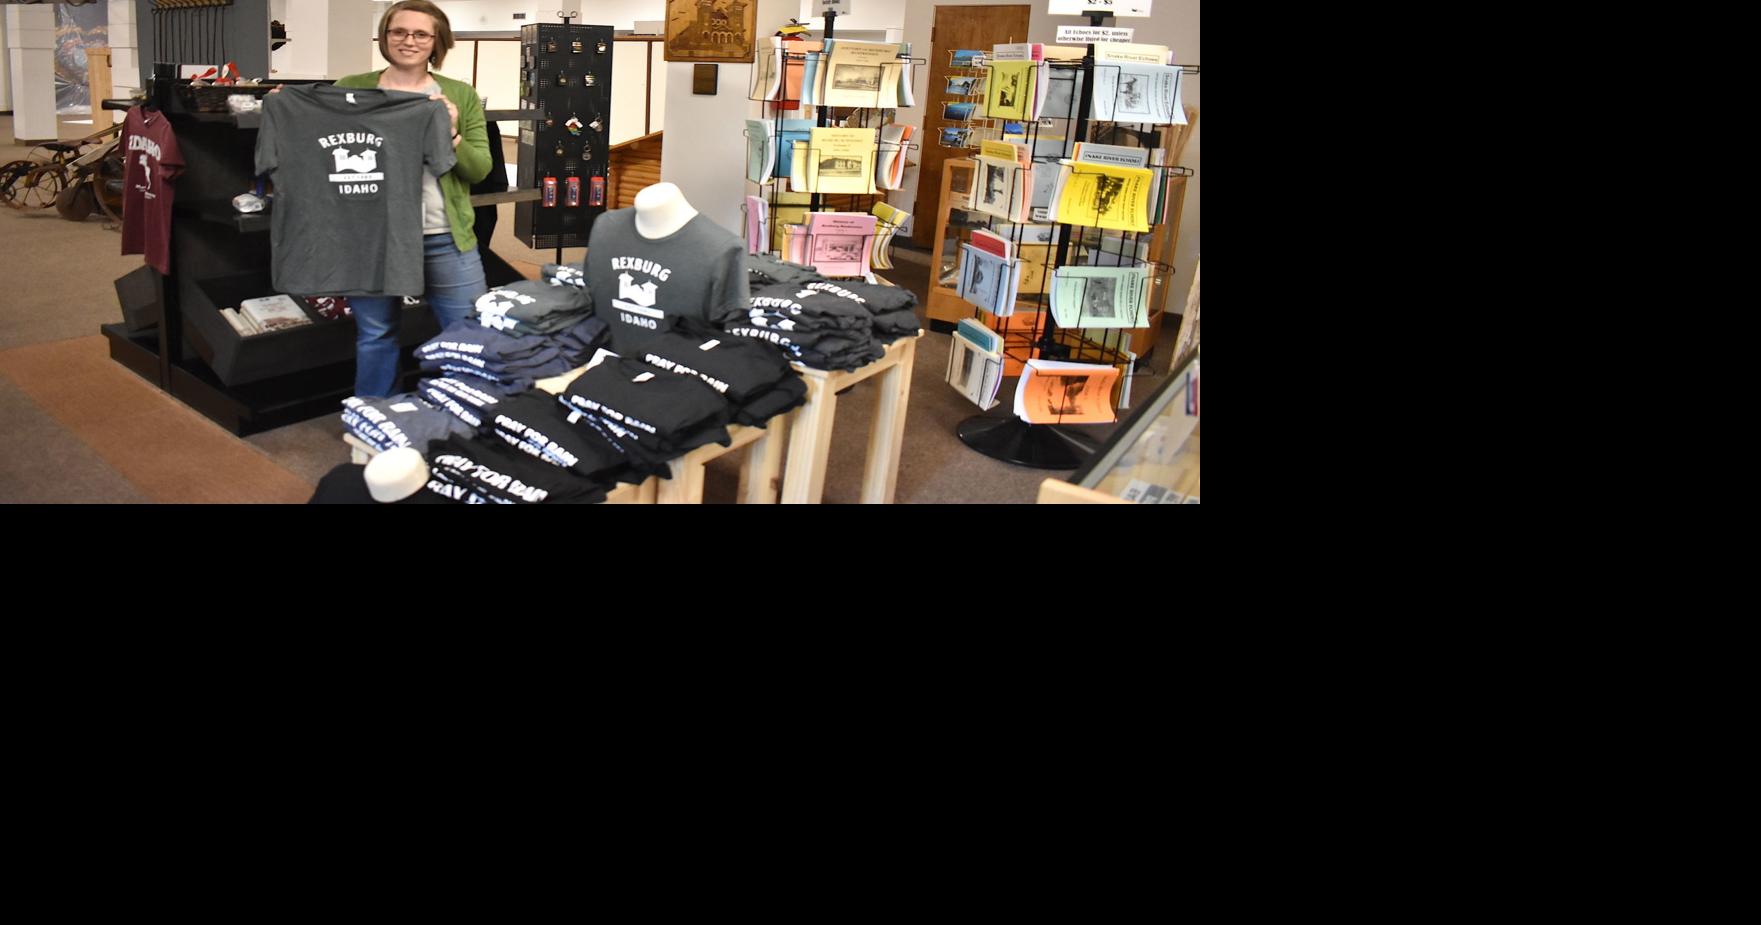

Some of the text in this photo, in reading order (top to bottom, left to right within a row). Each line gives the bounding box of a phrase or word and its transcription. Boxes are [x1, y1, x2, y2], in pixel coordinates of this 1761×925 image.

[128, 134, 162, 161] IDAHO
[317, 132, 384, 149] REXBURG
[338, 183, 379, 194] IDAHO
[611, 256, 672, 282] REXBURG
[620, 311, 658, 330] IDAHO
[495, 414, 527, 434] PRAY
[524, 427, 550, 448] FOR
[545, 441, 580, 468] RAIN
[471, 464, 512, 491] FOR
